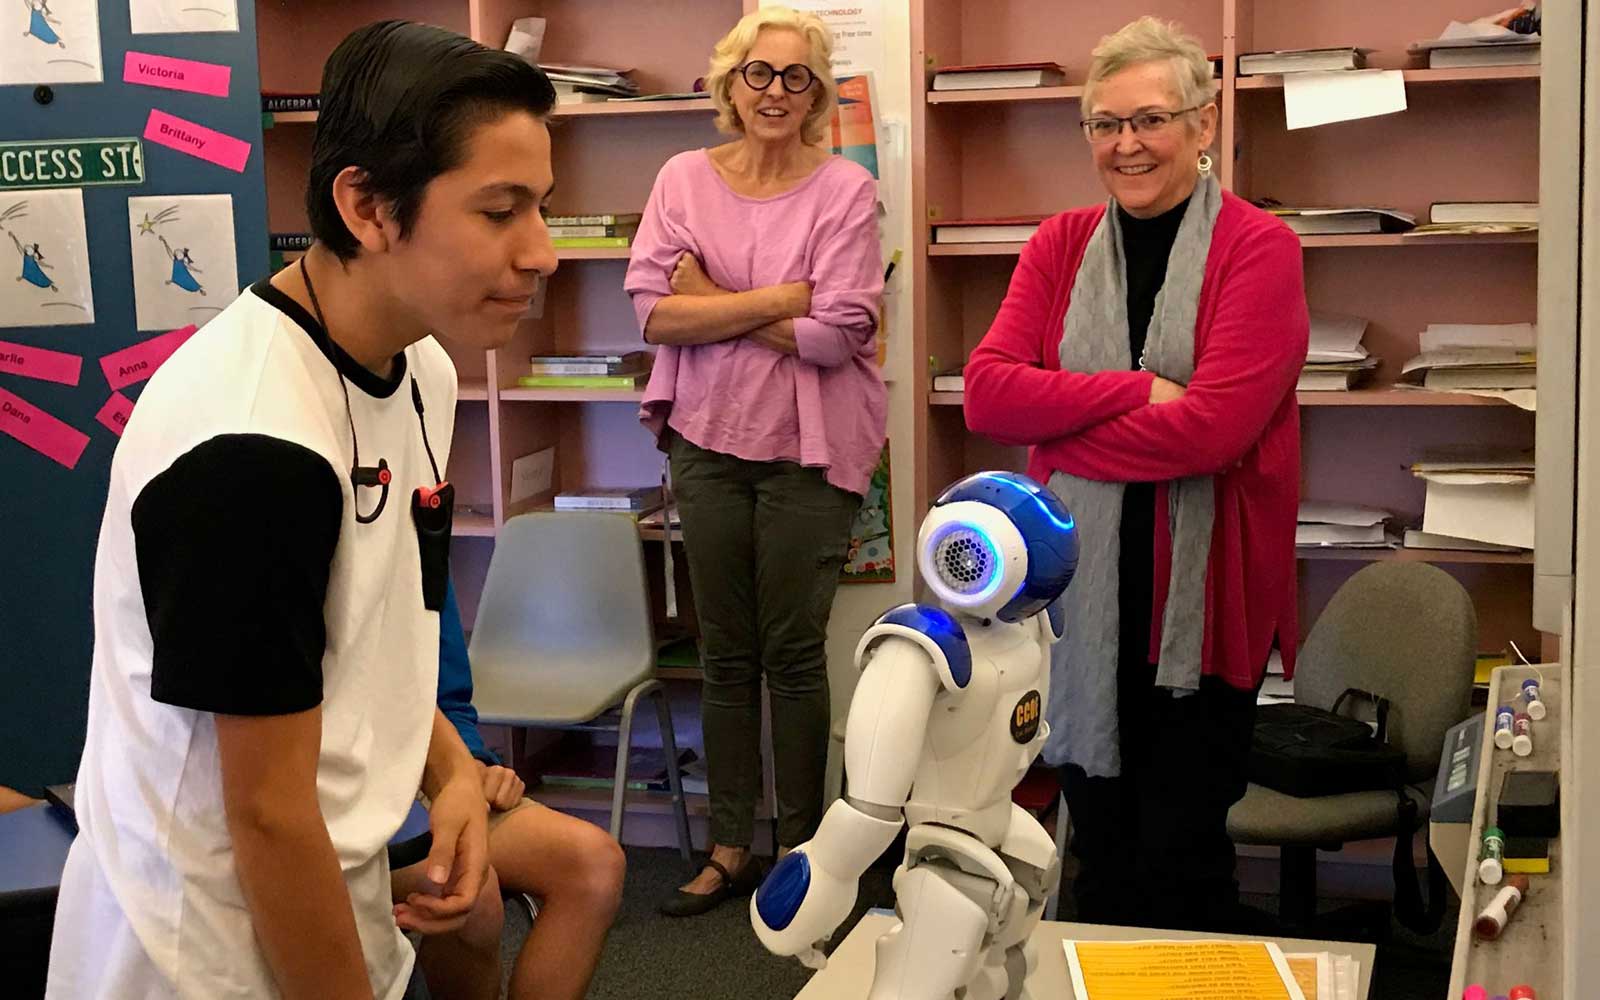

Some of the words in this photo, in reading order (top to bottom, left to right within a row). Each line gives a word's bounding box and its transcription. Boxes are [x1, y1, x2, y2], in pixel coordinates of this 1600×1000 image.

[138, 63, 185, 80] Victoria
[268, 98, 313, 109] ALGEBRA
[160, 123, 206, 149] Brittany
[1, 148, 83, 181] CCESS
[100, 146, 131, 177] ST
[119, 360, 148, 377] Anna
[2, 400, 31, 425] Dana
